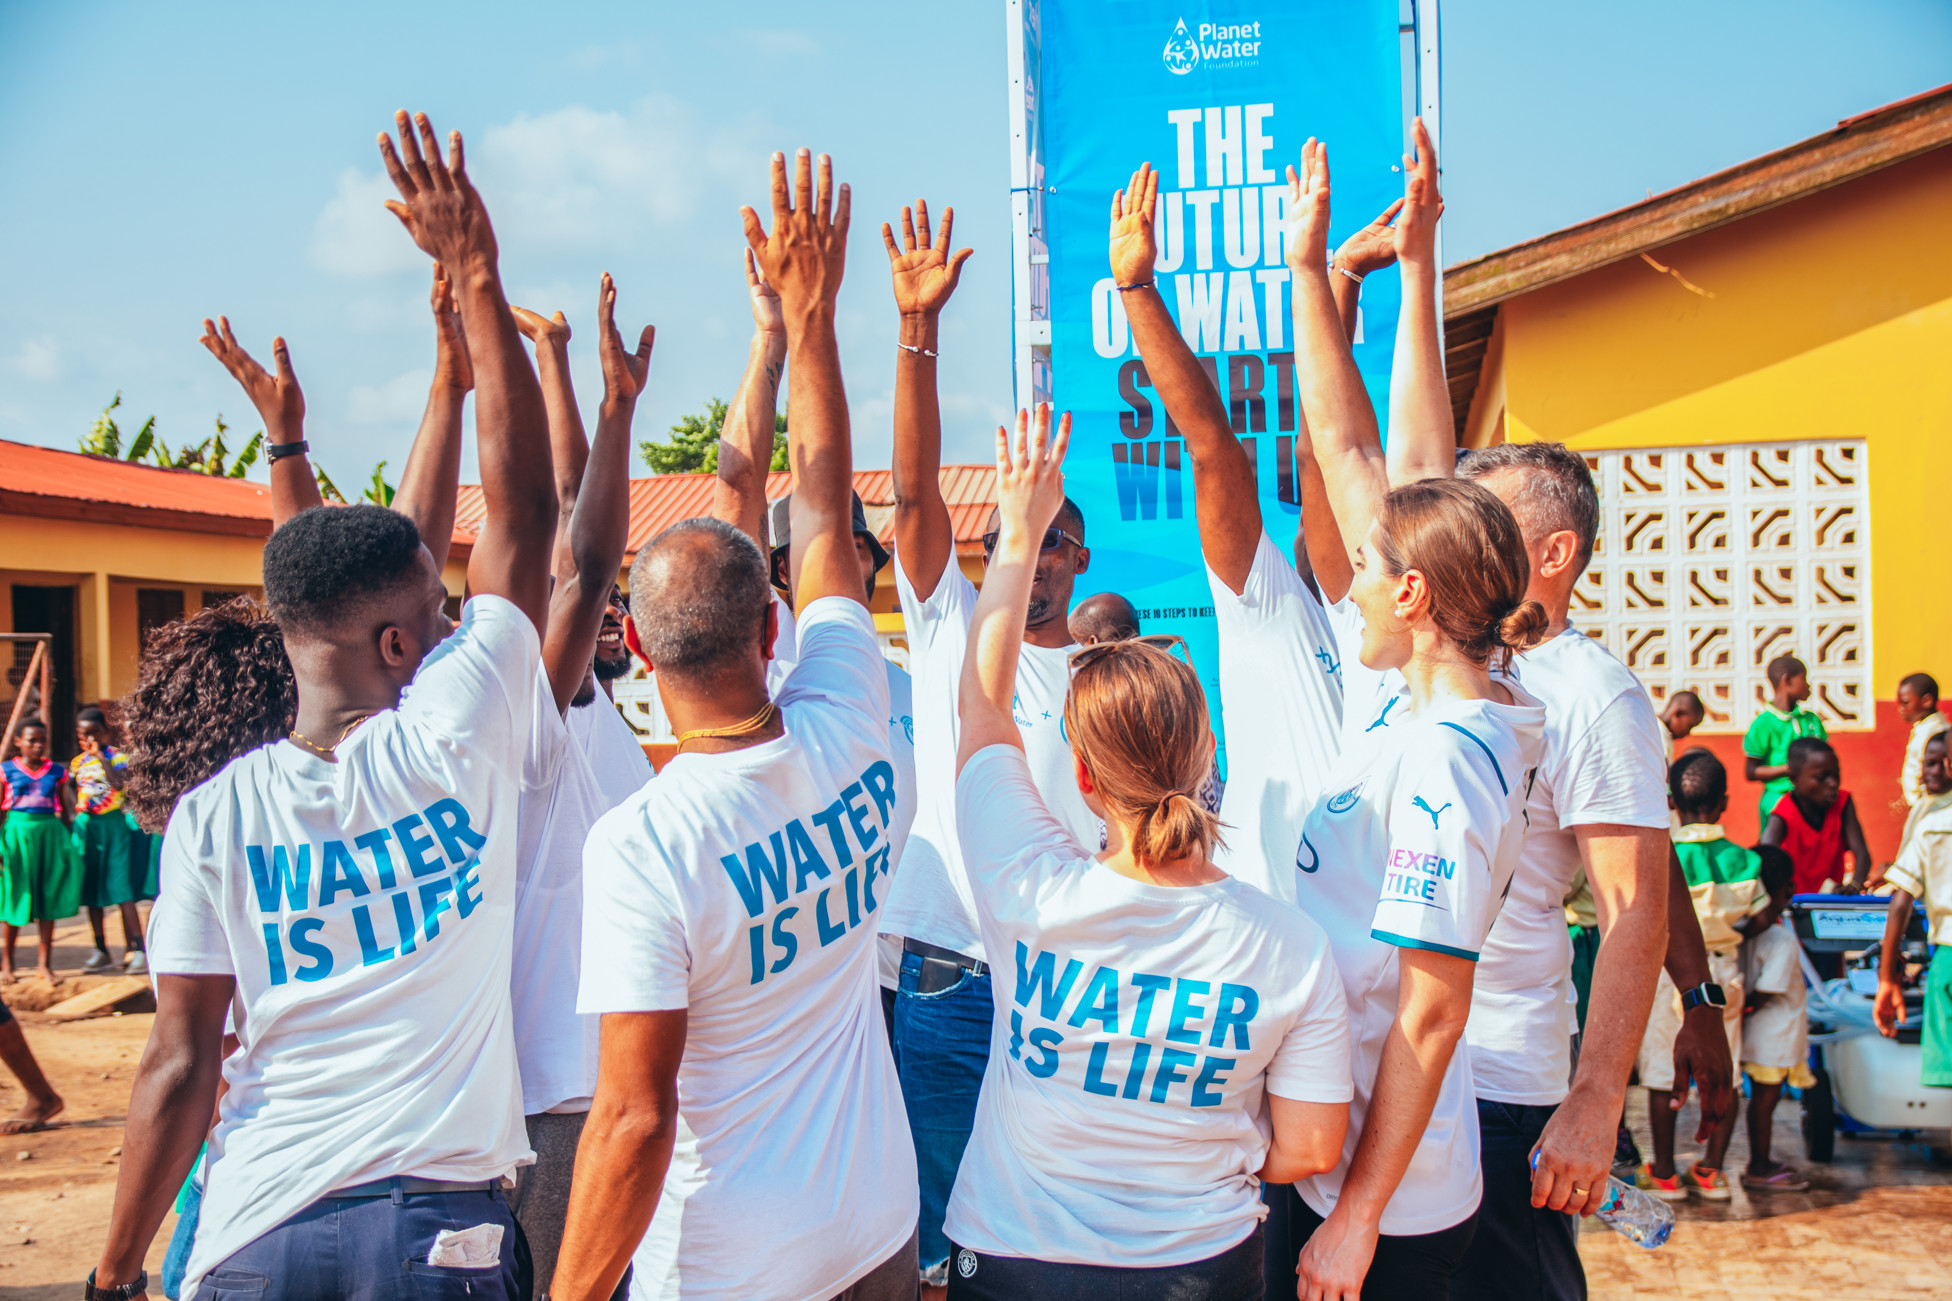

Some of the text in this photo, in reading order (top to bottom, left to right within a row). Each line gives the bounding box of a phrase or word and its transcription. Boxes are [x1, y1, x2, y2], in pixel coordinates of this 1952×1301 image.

[1199, 21, 1261, 41] Planet
[1200, 41, 1261, 60] Water
[1168, 103, 1275, 188] THE
[1120, 184, 1334, 273] UTUR
[1091, 267, 1365, 359] O WAT
[1117, 352, 1297, 440] SRT
[1112, 436, 1258, 521] WI
[1135, 608, 1151, 619] ESE
[1153, 608, 1161, 619] 10
[1162, 607, 1186, 618] STEPS
[1188, 607, 1198, 618] TO
[246, 797, 487, 913] WATER
[720, 760, 896, 919] WATER
[262, 855, 484, 986] IS LIFE
[1387, 872, 1437, 901] TIRE
[749, 907, 800, 986] IS
[1014, 939, 1260, 1051] WATER
[1008, 1008, 1237, 1107] IS LIFE
